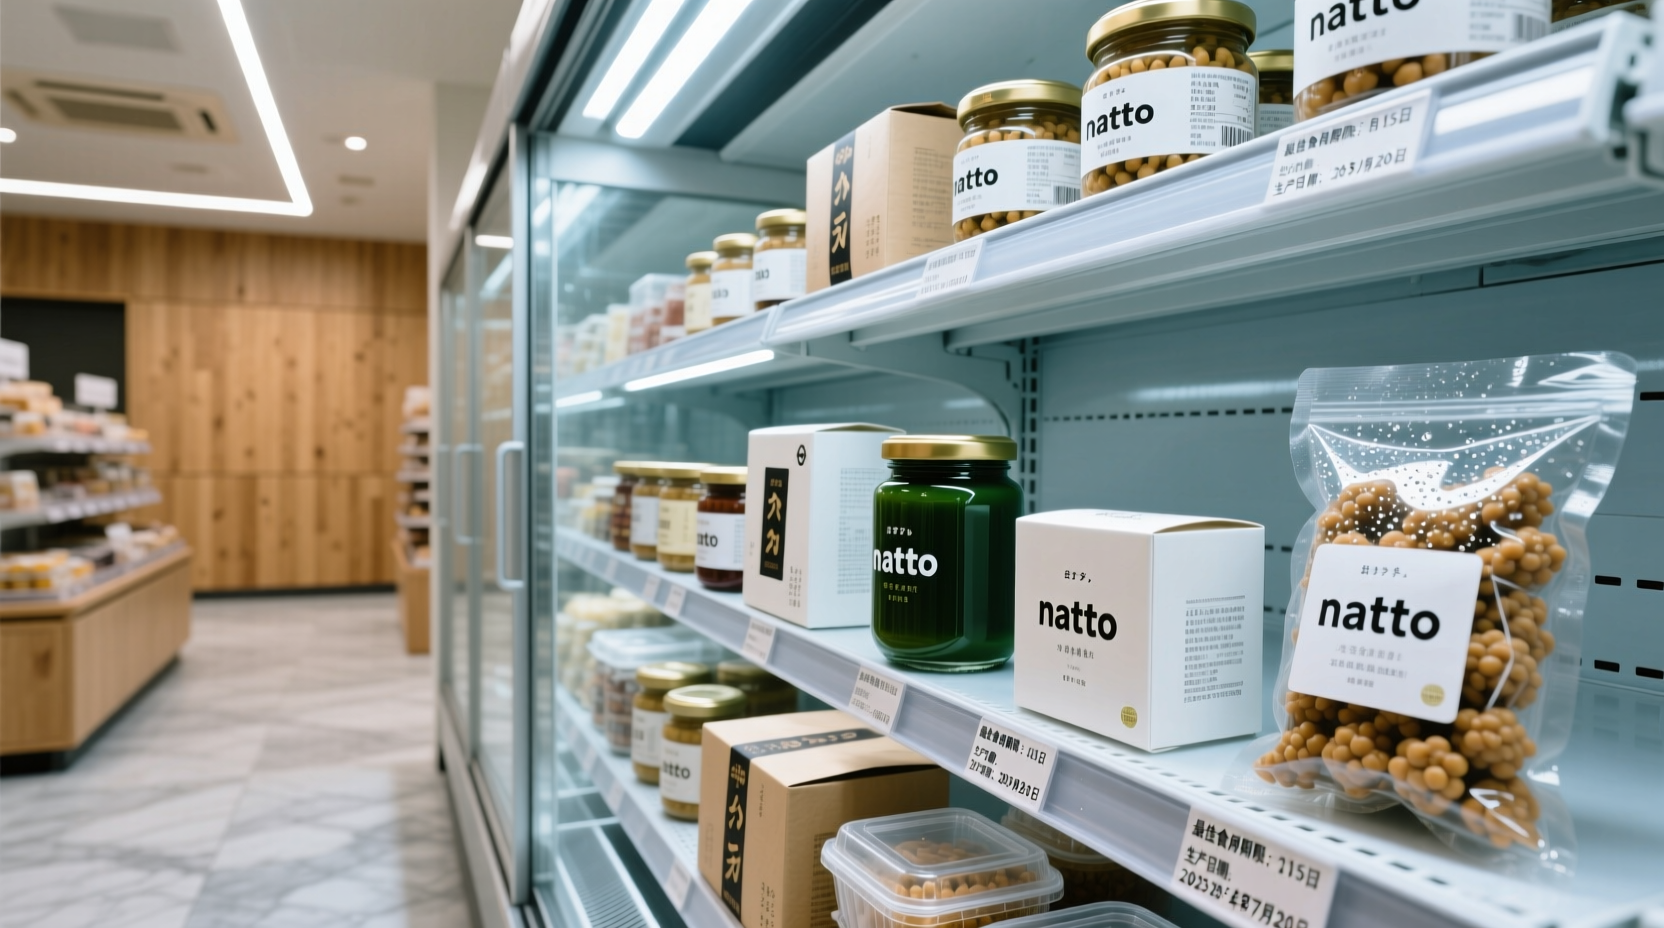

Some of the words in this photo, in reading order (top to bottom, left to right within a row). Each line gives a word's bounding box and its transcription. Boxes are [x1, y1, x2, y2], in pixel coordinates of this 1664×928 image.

[1087, 102, 1154, 141] natto
[873, 547, 938, 577] natto
[1039, 600, 1118, 641] natto
[1318, 597, 1441, 641] natto
